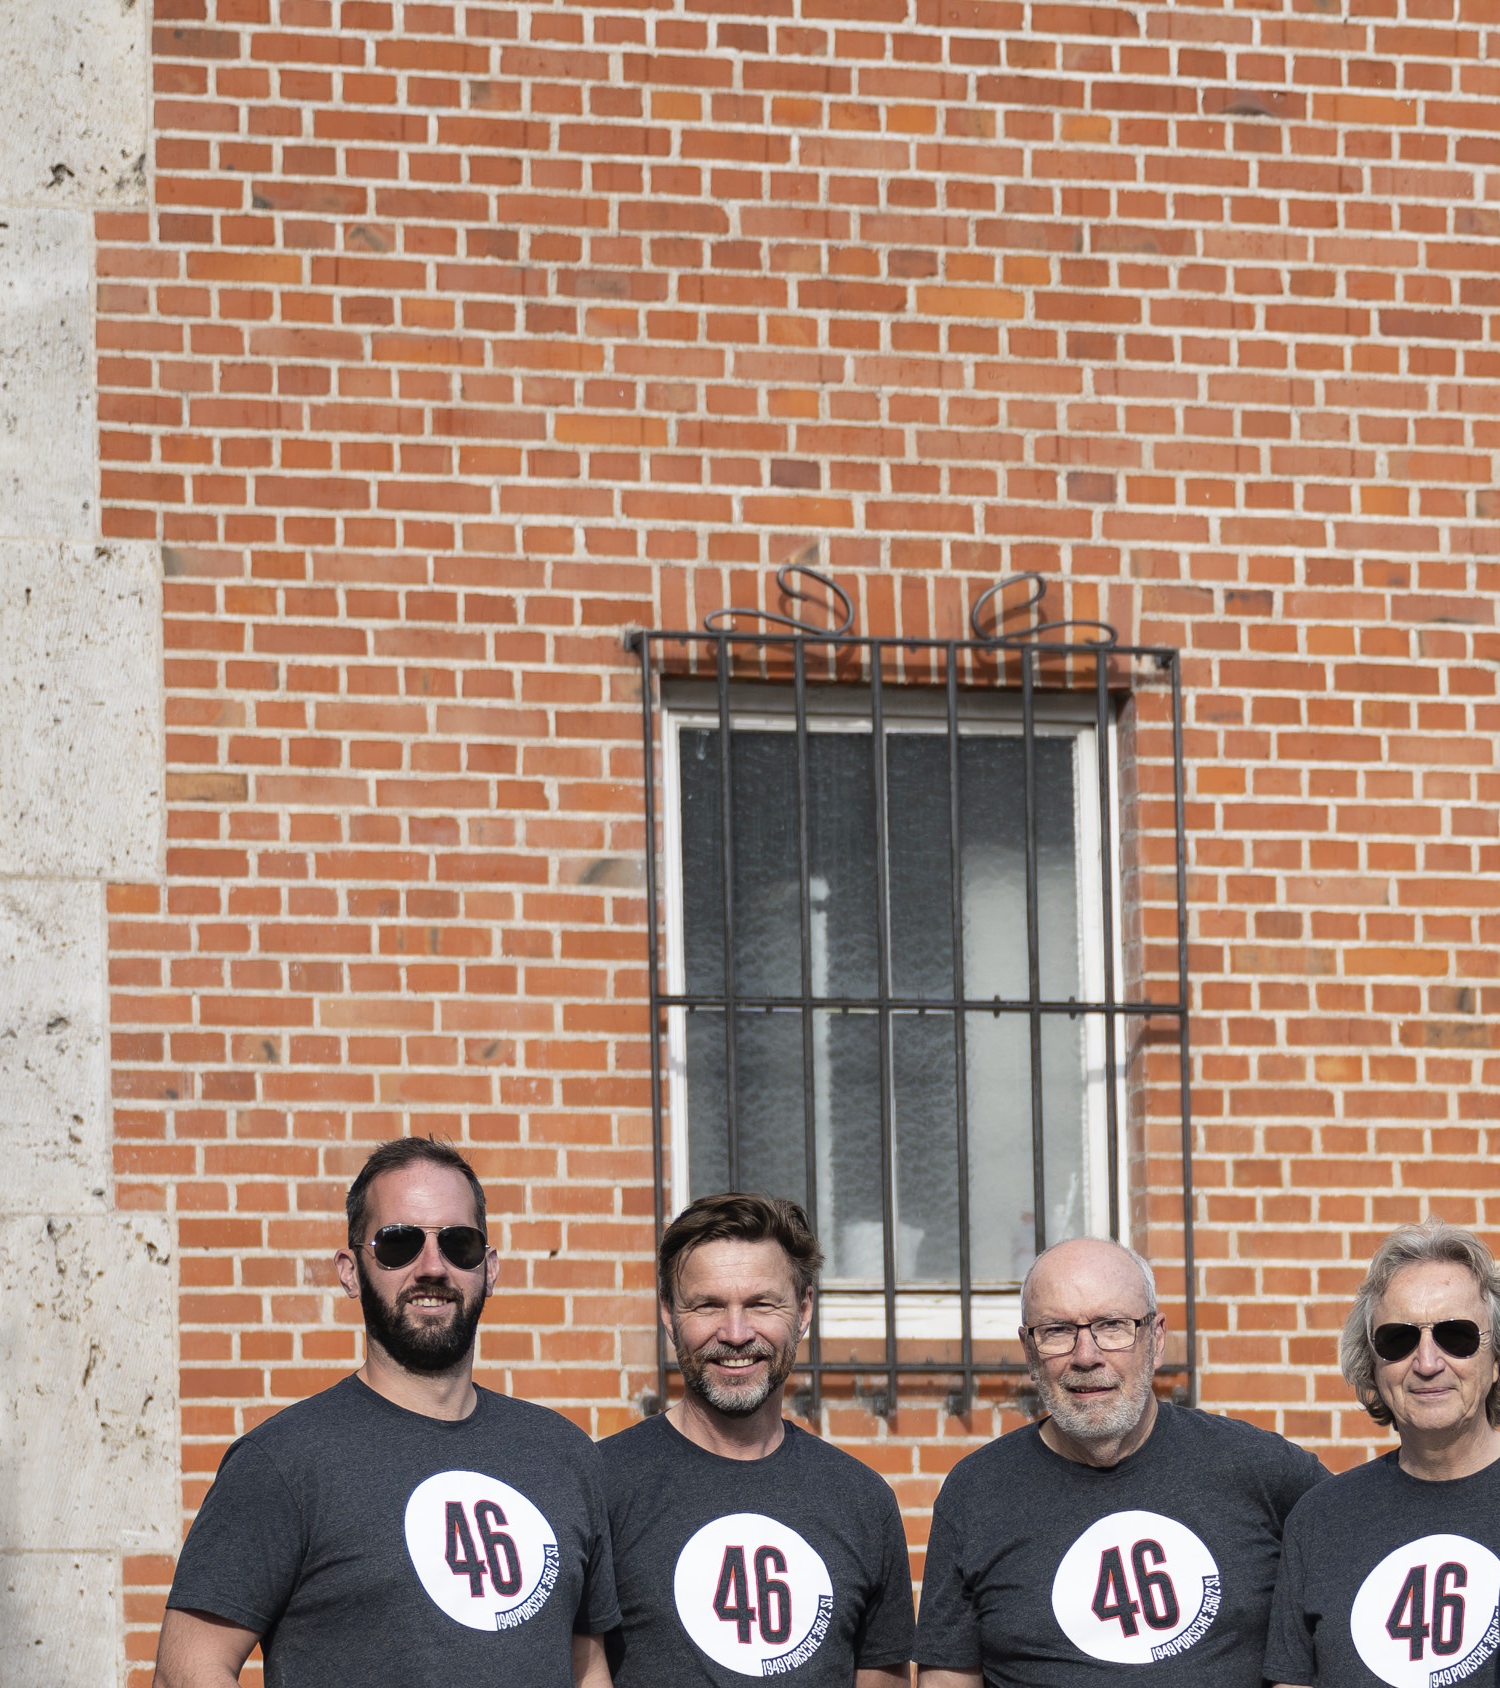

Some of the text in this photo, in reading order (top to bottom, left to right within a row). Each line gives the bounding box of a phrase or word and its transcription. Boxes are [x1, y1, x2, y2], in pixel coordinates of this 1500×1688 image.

[445, 1500, 522, 1597] 46
[496, 1545, 560, 1630] 1949 PORSCHE 356/2 SL
[1091, 1538, 1180, 1638] 46
[713, 1545, 792, 1645] 46
[762, 1596, 834, 1676] 1949 PORSCHE 356/2 SL
[1152, 1576, 1222, 1661] 1949 PORSCHE 356/2 SL
[1385, 1561, 1467, 1661] 46
[1430, 1670, 1452, 1688] 1949
[1450, 1644, 1493, 1682] PORSCHE
